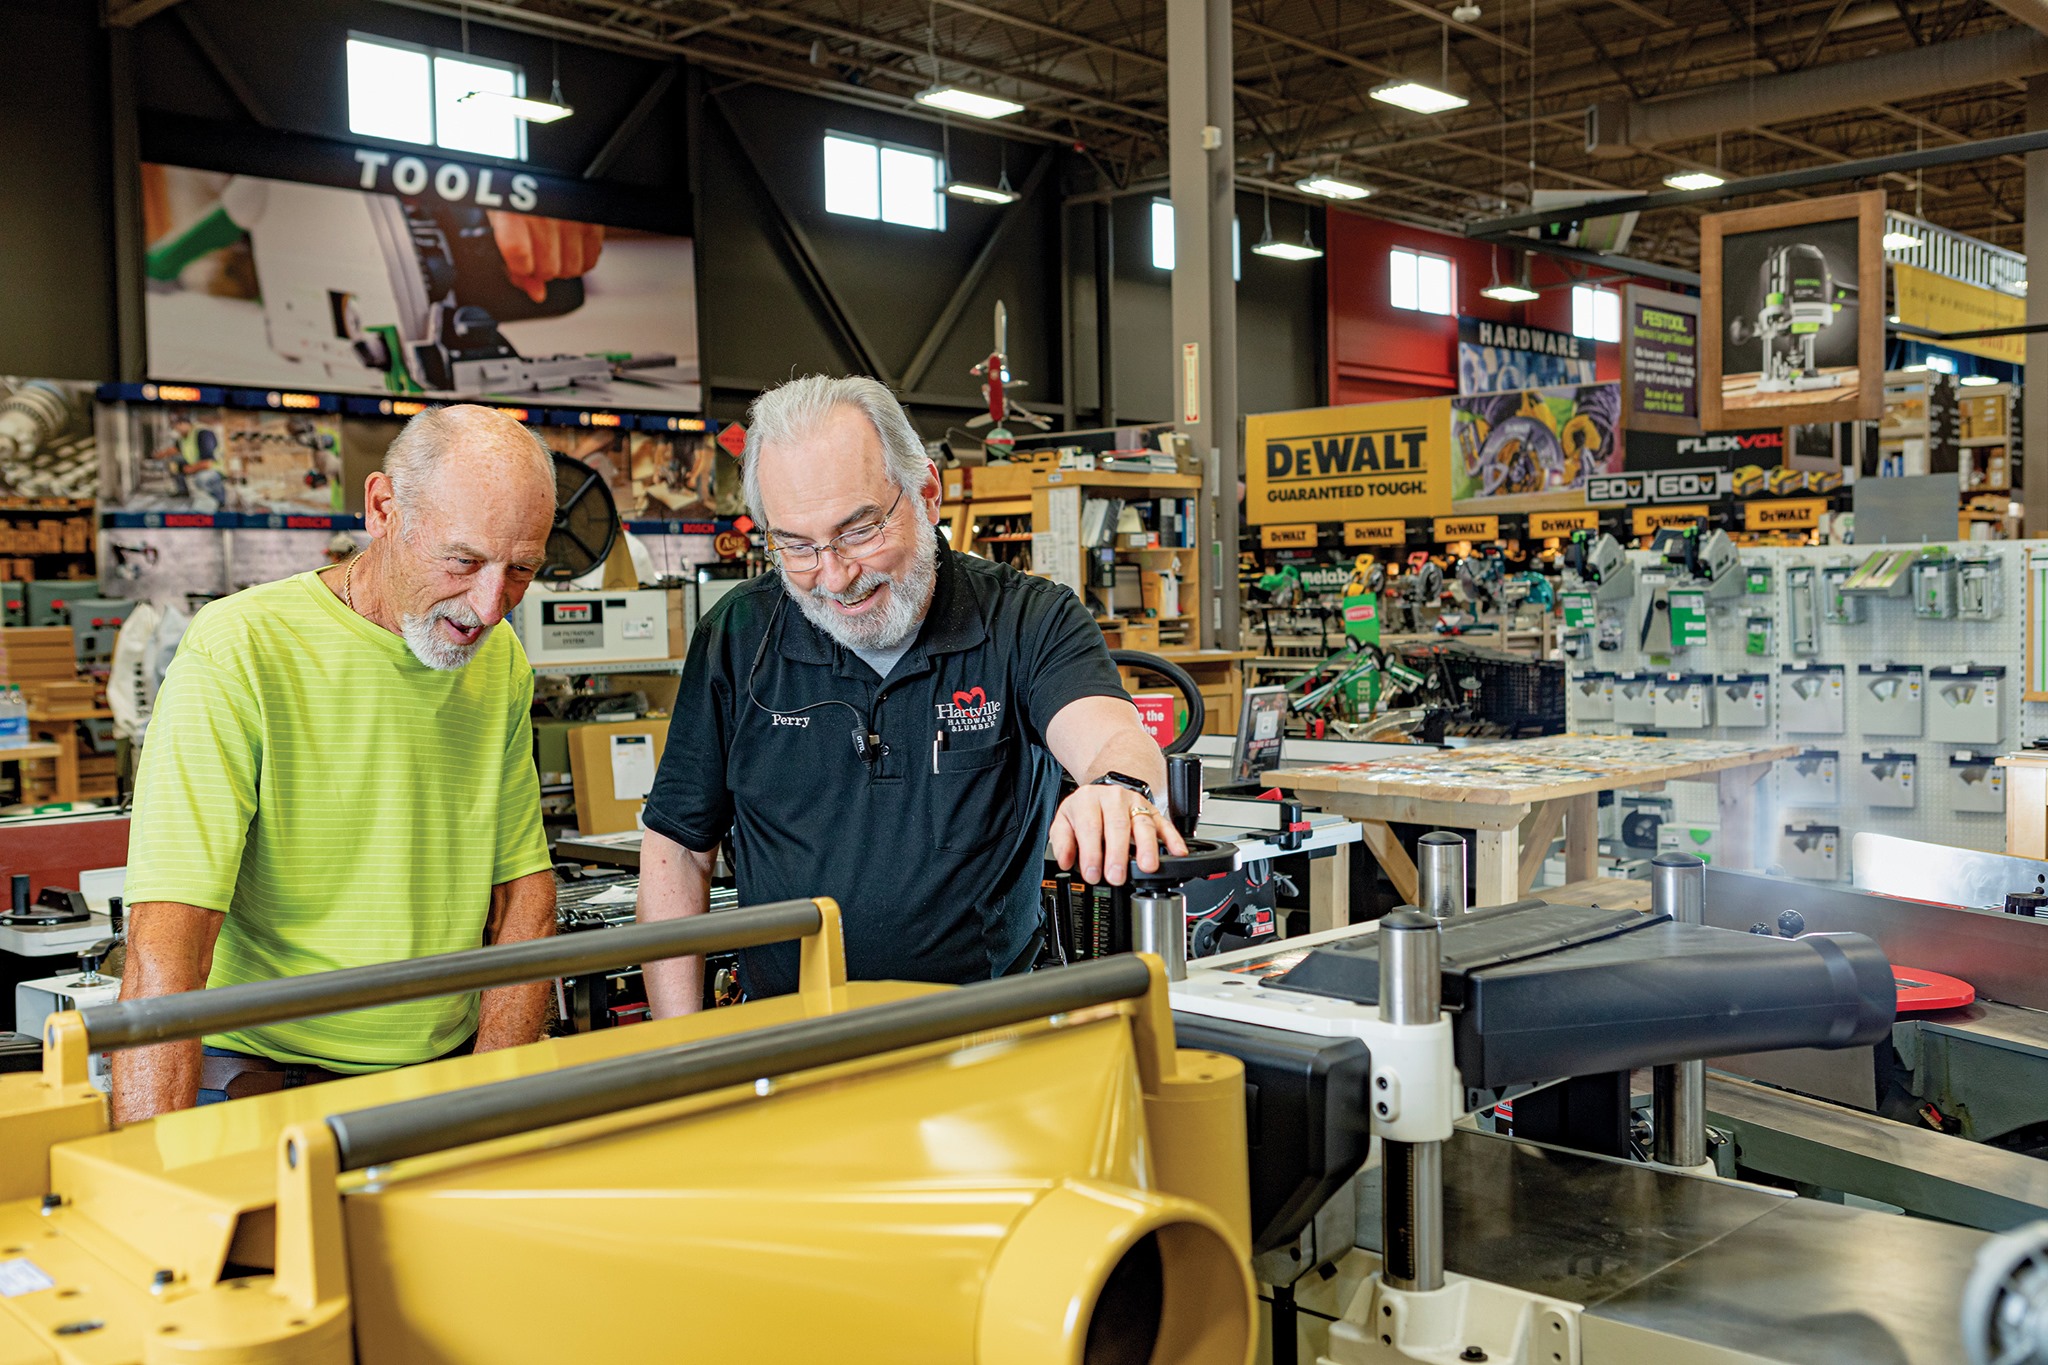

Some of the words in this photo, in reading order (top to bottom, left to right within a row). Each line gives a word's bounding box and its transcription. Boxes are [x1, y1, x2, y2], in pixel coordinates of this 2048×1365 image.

[354, 150, 539, 211] TOOLS
[1642, 309, 1687, 332] FESTOOL
[1479, 321, 1579, 358] HARDWARE
[1677, 432, 1784, 454] FLEXVOL
[1268, 485, 1364, 502] GUARANTEED
[1368, 481, 1427, 497] TOUGH.
[683, 524, 715, 534] BOSCH
[558, 611, 587, 619] JET
[935, 701, 1001, 719] Hartville
[1146, 710, 1165, 722] the
[772, 714, 810, 728] Perry
[948, 714, 997, 726] HARDWARE
[1142, 723, 1158, 736] he
